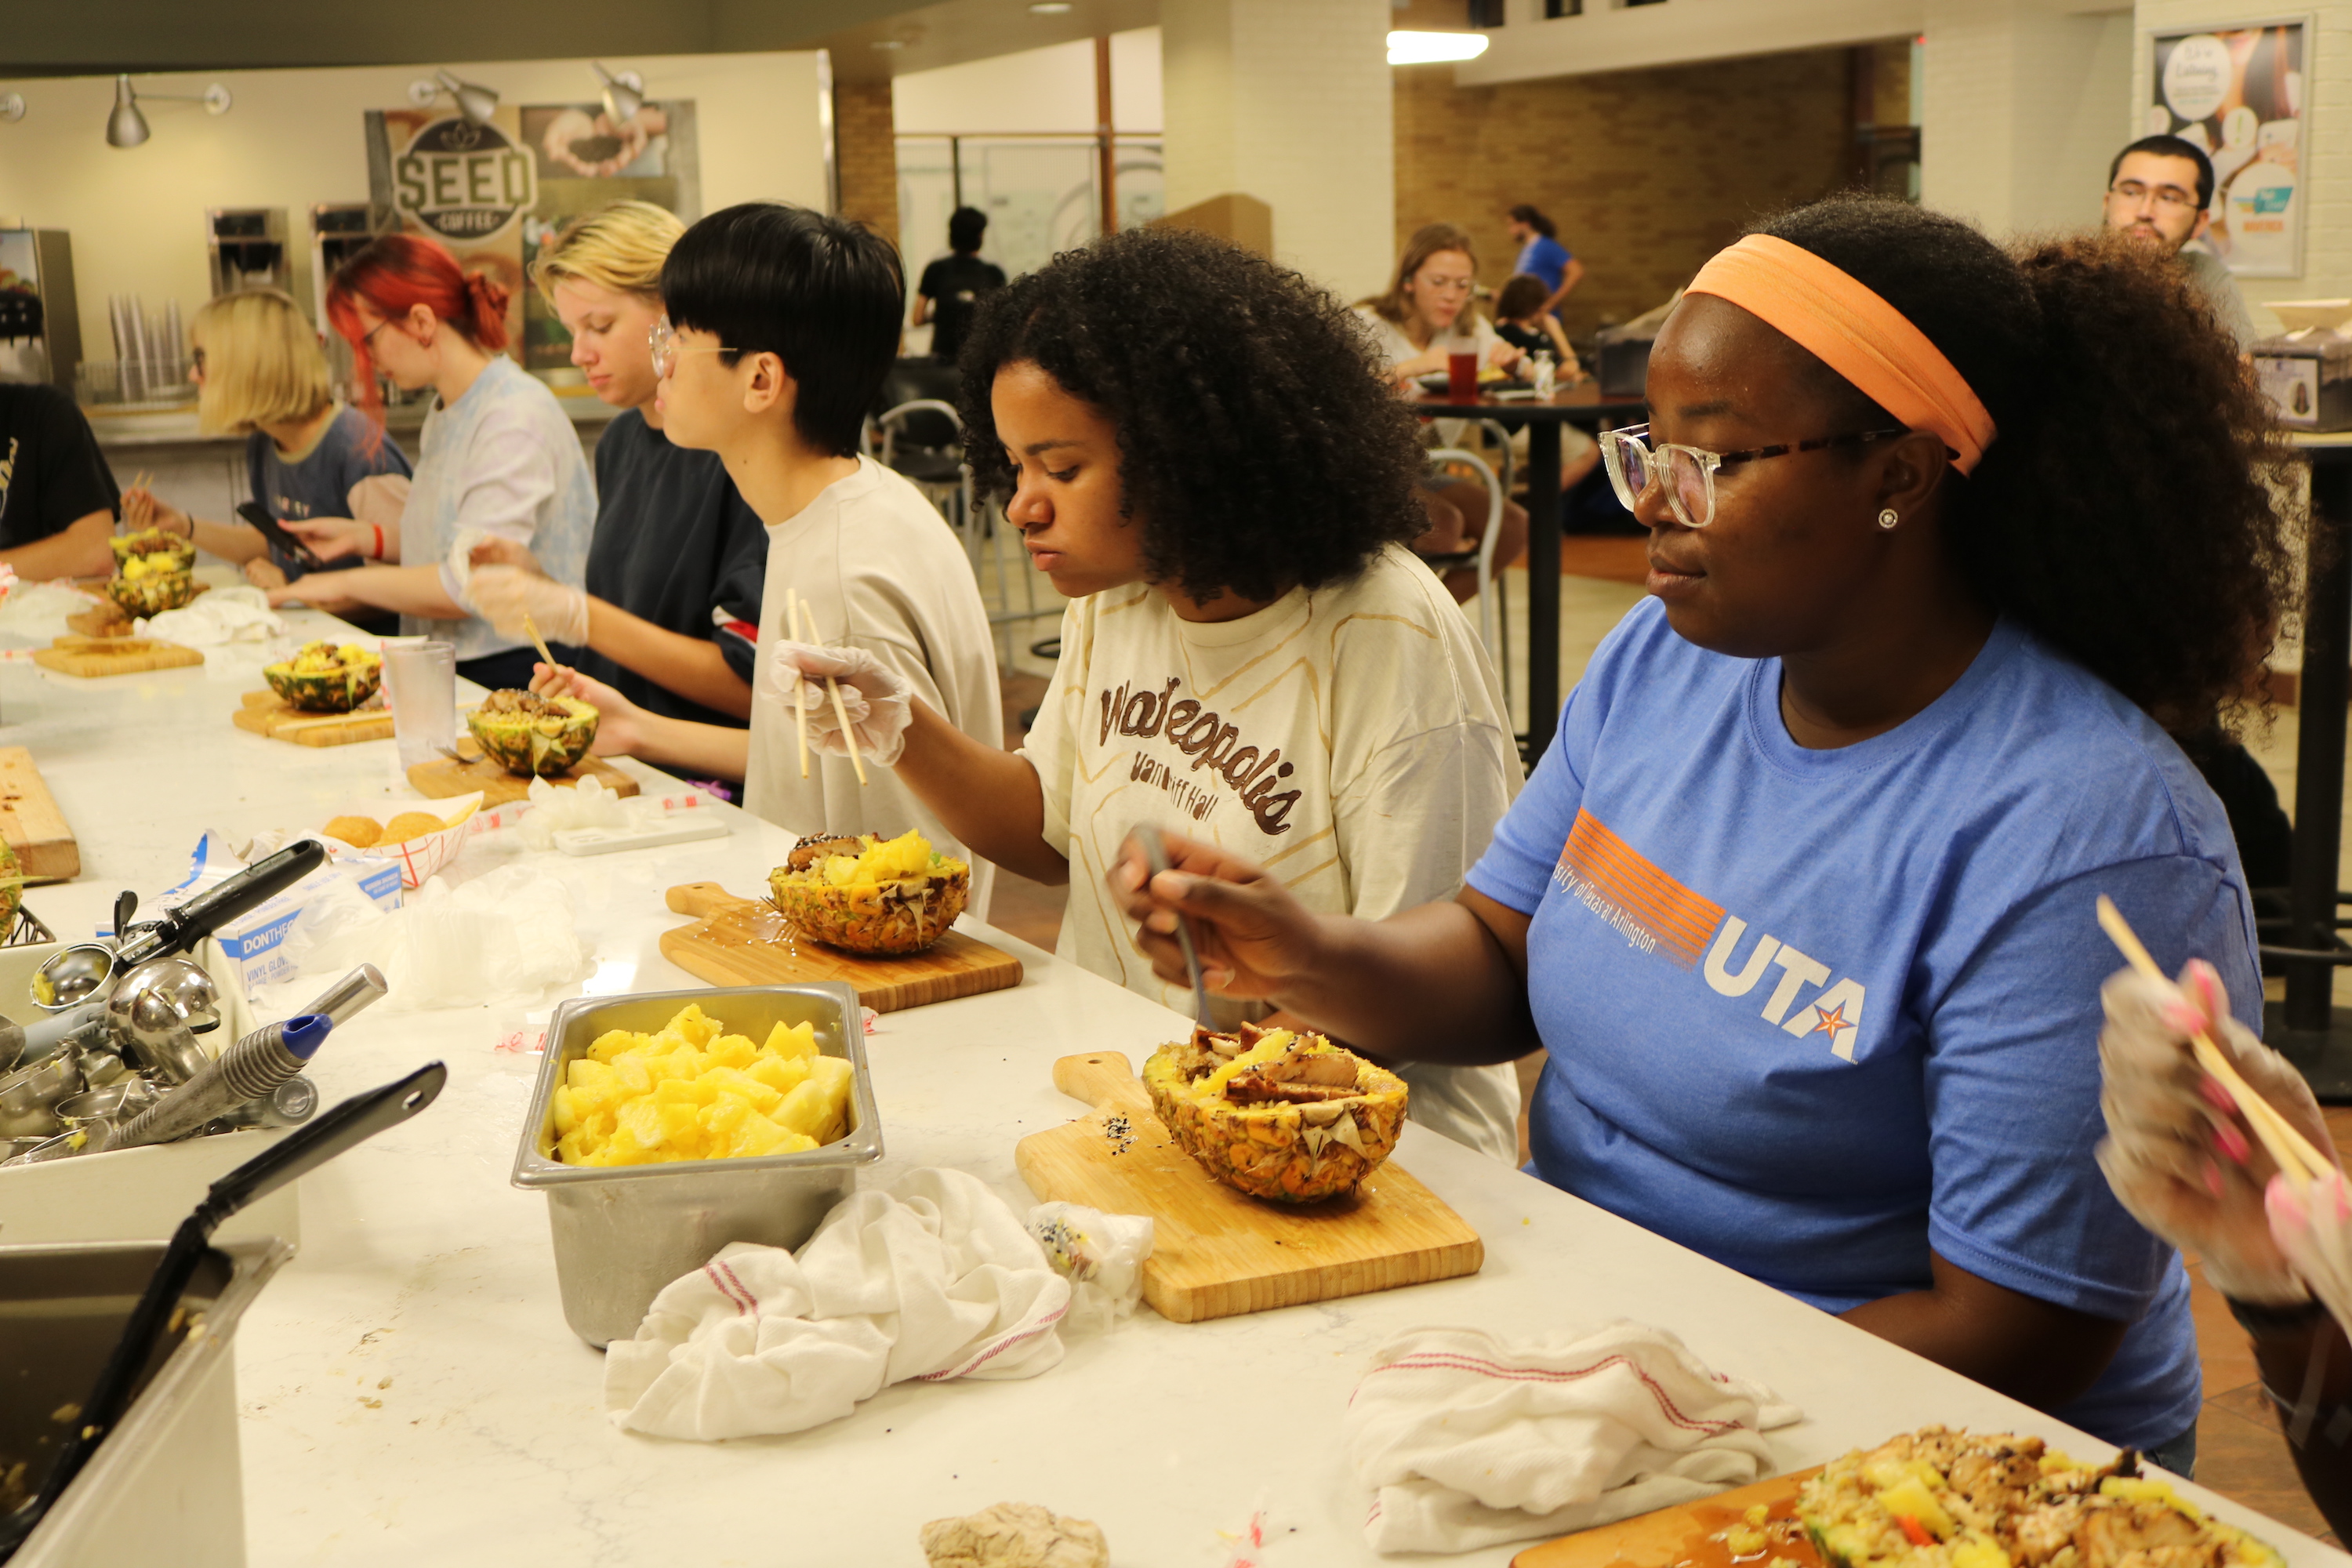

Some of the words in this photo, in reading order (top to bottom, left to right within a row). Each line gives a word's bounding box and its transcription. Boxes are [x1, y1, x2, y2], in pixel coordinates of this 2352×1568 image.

[397, 152, 531, 209] SEED
[439, 211, 494, 231] COFFEE
[1184, 786, 1219, 822] Hall
[1573, 881, 1592, 898] of
[1581, 884, 1606, 915] Texas
[1600, 903, 1614, 922] at
[1609, 906, 1656, 955] Arlington
[246, 964, 267, 982] VINYL
[268, 956, 289, 973] GLOV
[1704, 915, 1866, 1063] UTA
